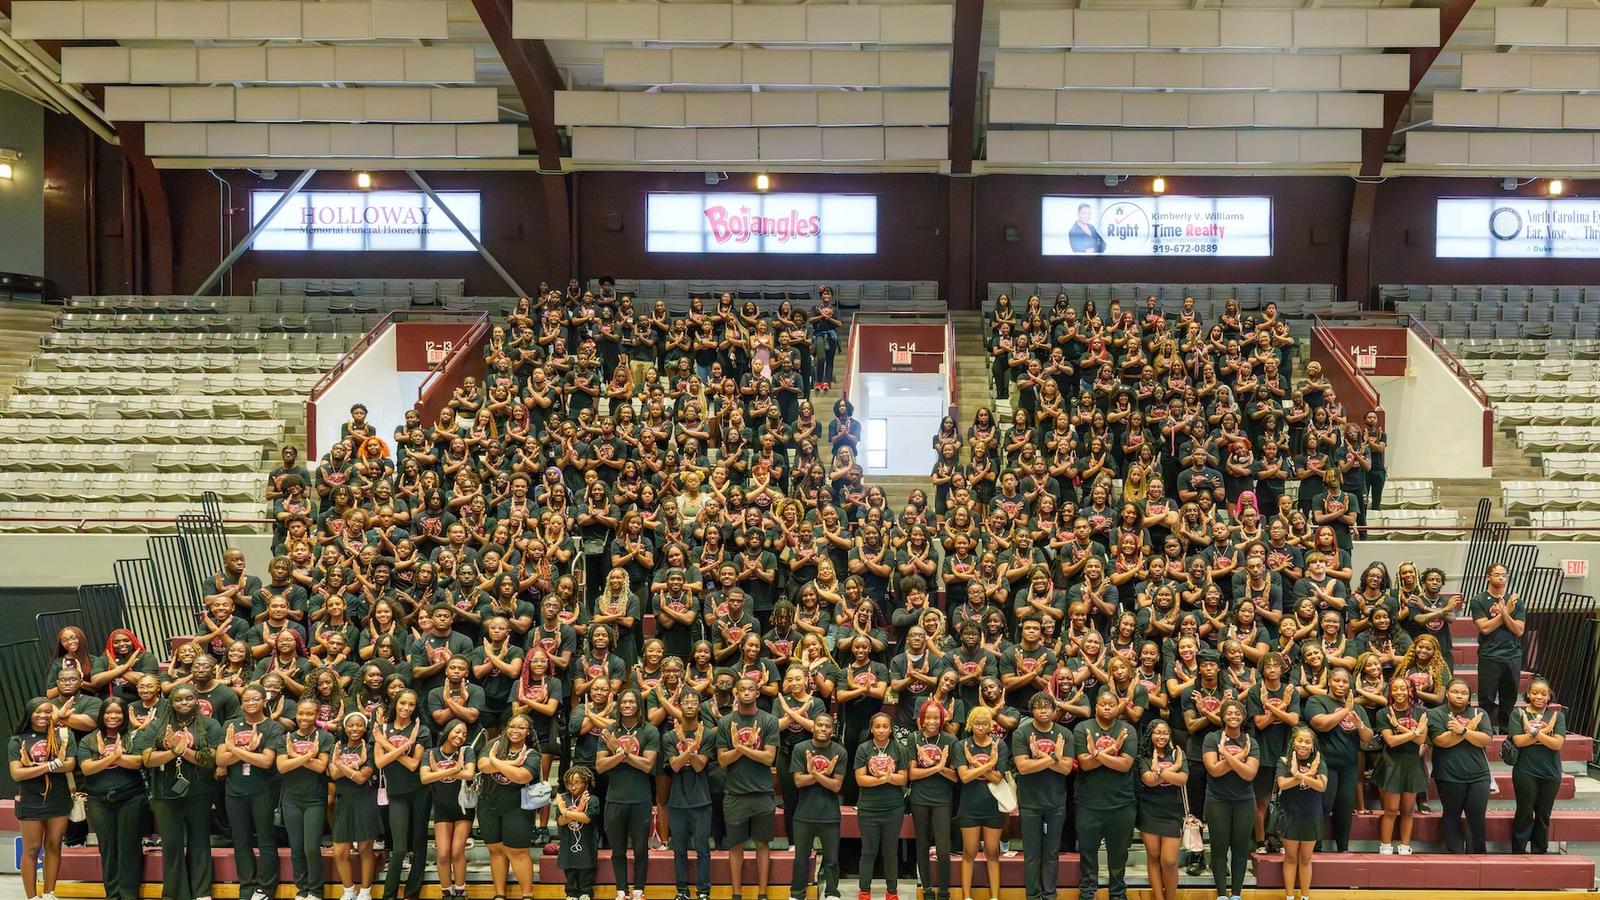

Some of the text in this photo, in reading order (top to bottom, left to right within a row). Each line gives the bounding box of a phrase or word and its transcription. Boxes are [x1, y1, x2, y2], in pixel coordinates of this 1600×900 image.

[300, 206, 432, 225] HOLLOWAY
[1152, 212, 1245, 222] Kimberly V. Williams
[1527, 209, 1551, 223] North
[1552, 209, 1590, 223] Carolina
[300, 226, 434, 235] Memorial Funeral Home, Inc.
[704, 204, 821, 245] Bojangles
[1152, 223, 1225, 239] Time Realty
[1107, 224, 1139, 240] Right
[1546, 225, 1567, 239] Nose
[1153, 244, 1218, 253] 919-672-0889
[1567, 561, 1585, 575] EXIT
